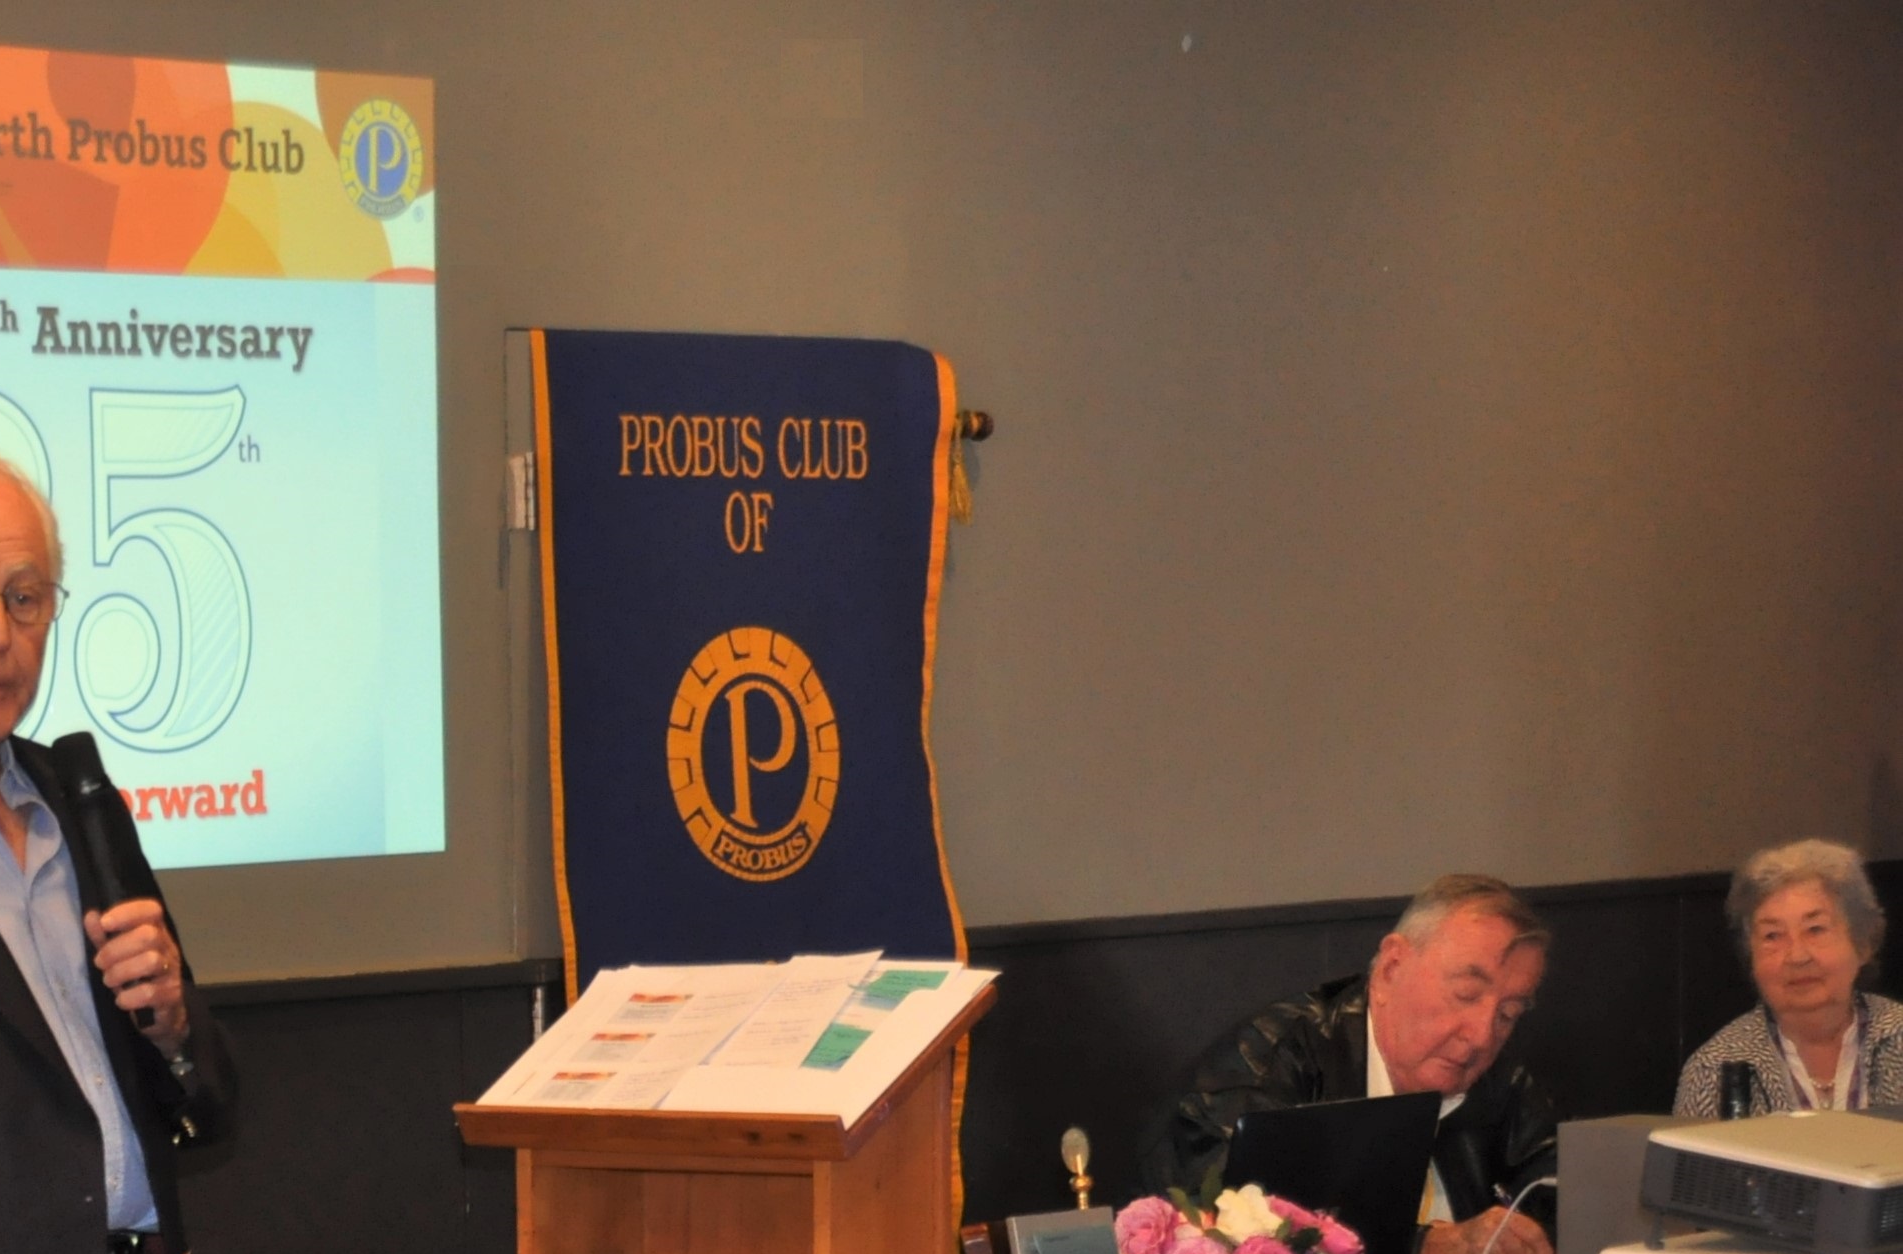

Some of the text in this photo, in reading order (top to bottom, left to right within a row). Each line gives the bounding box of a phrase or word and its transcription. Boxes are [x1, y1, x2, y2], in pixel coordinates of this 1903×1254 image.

[67, 118, 207, 170] Probus
[218, 127, 305, 175] Club
[32, 306, 313, 373] Anniversary
[618, 414, 869, 481] PROBUS CLUB
[724, 491, 774, 554] OF
[724, 679, 797, 828] P
[713, 832, 808, 871] PROBUS
